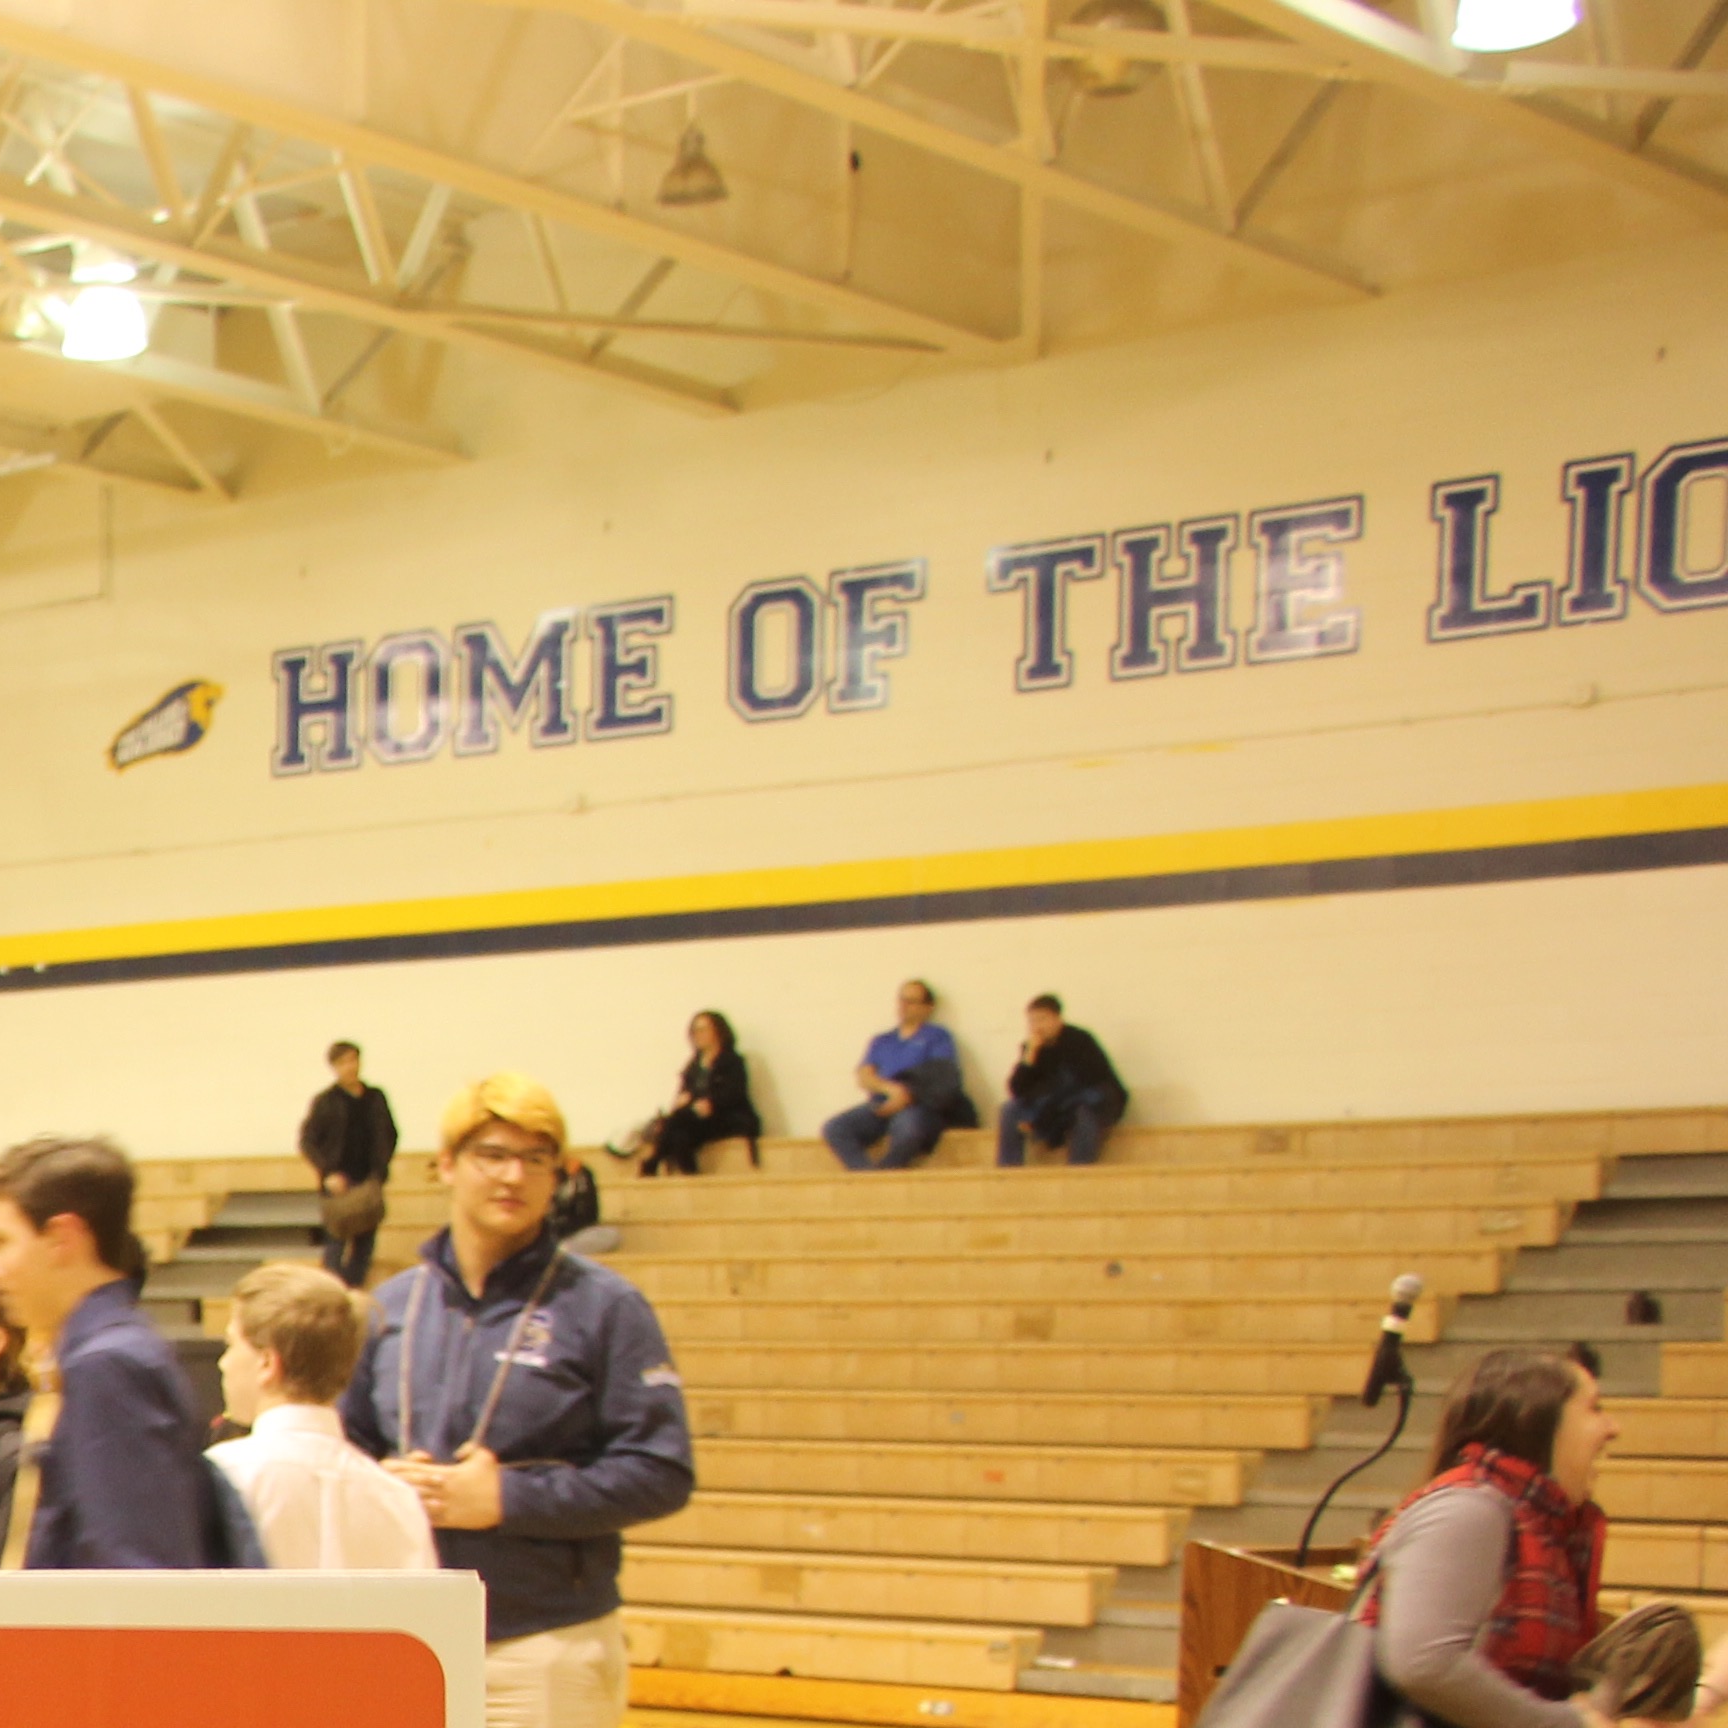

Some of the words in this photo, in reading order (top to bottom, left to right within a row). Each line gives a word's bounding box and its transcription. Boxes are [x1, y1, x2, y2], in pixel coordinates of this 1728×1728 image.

[271, 594, 675, 779] HOME
[725, 556, 928, 723] OF
[987, 493, 1365, 694] THE
[1426, 436, 1728, 643] LIO
